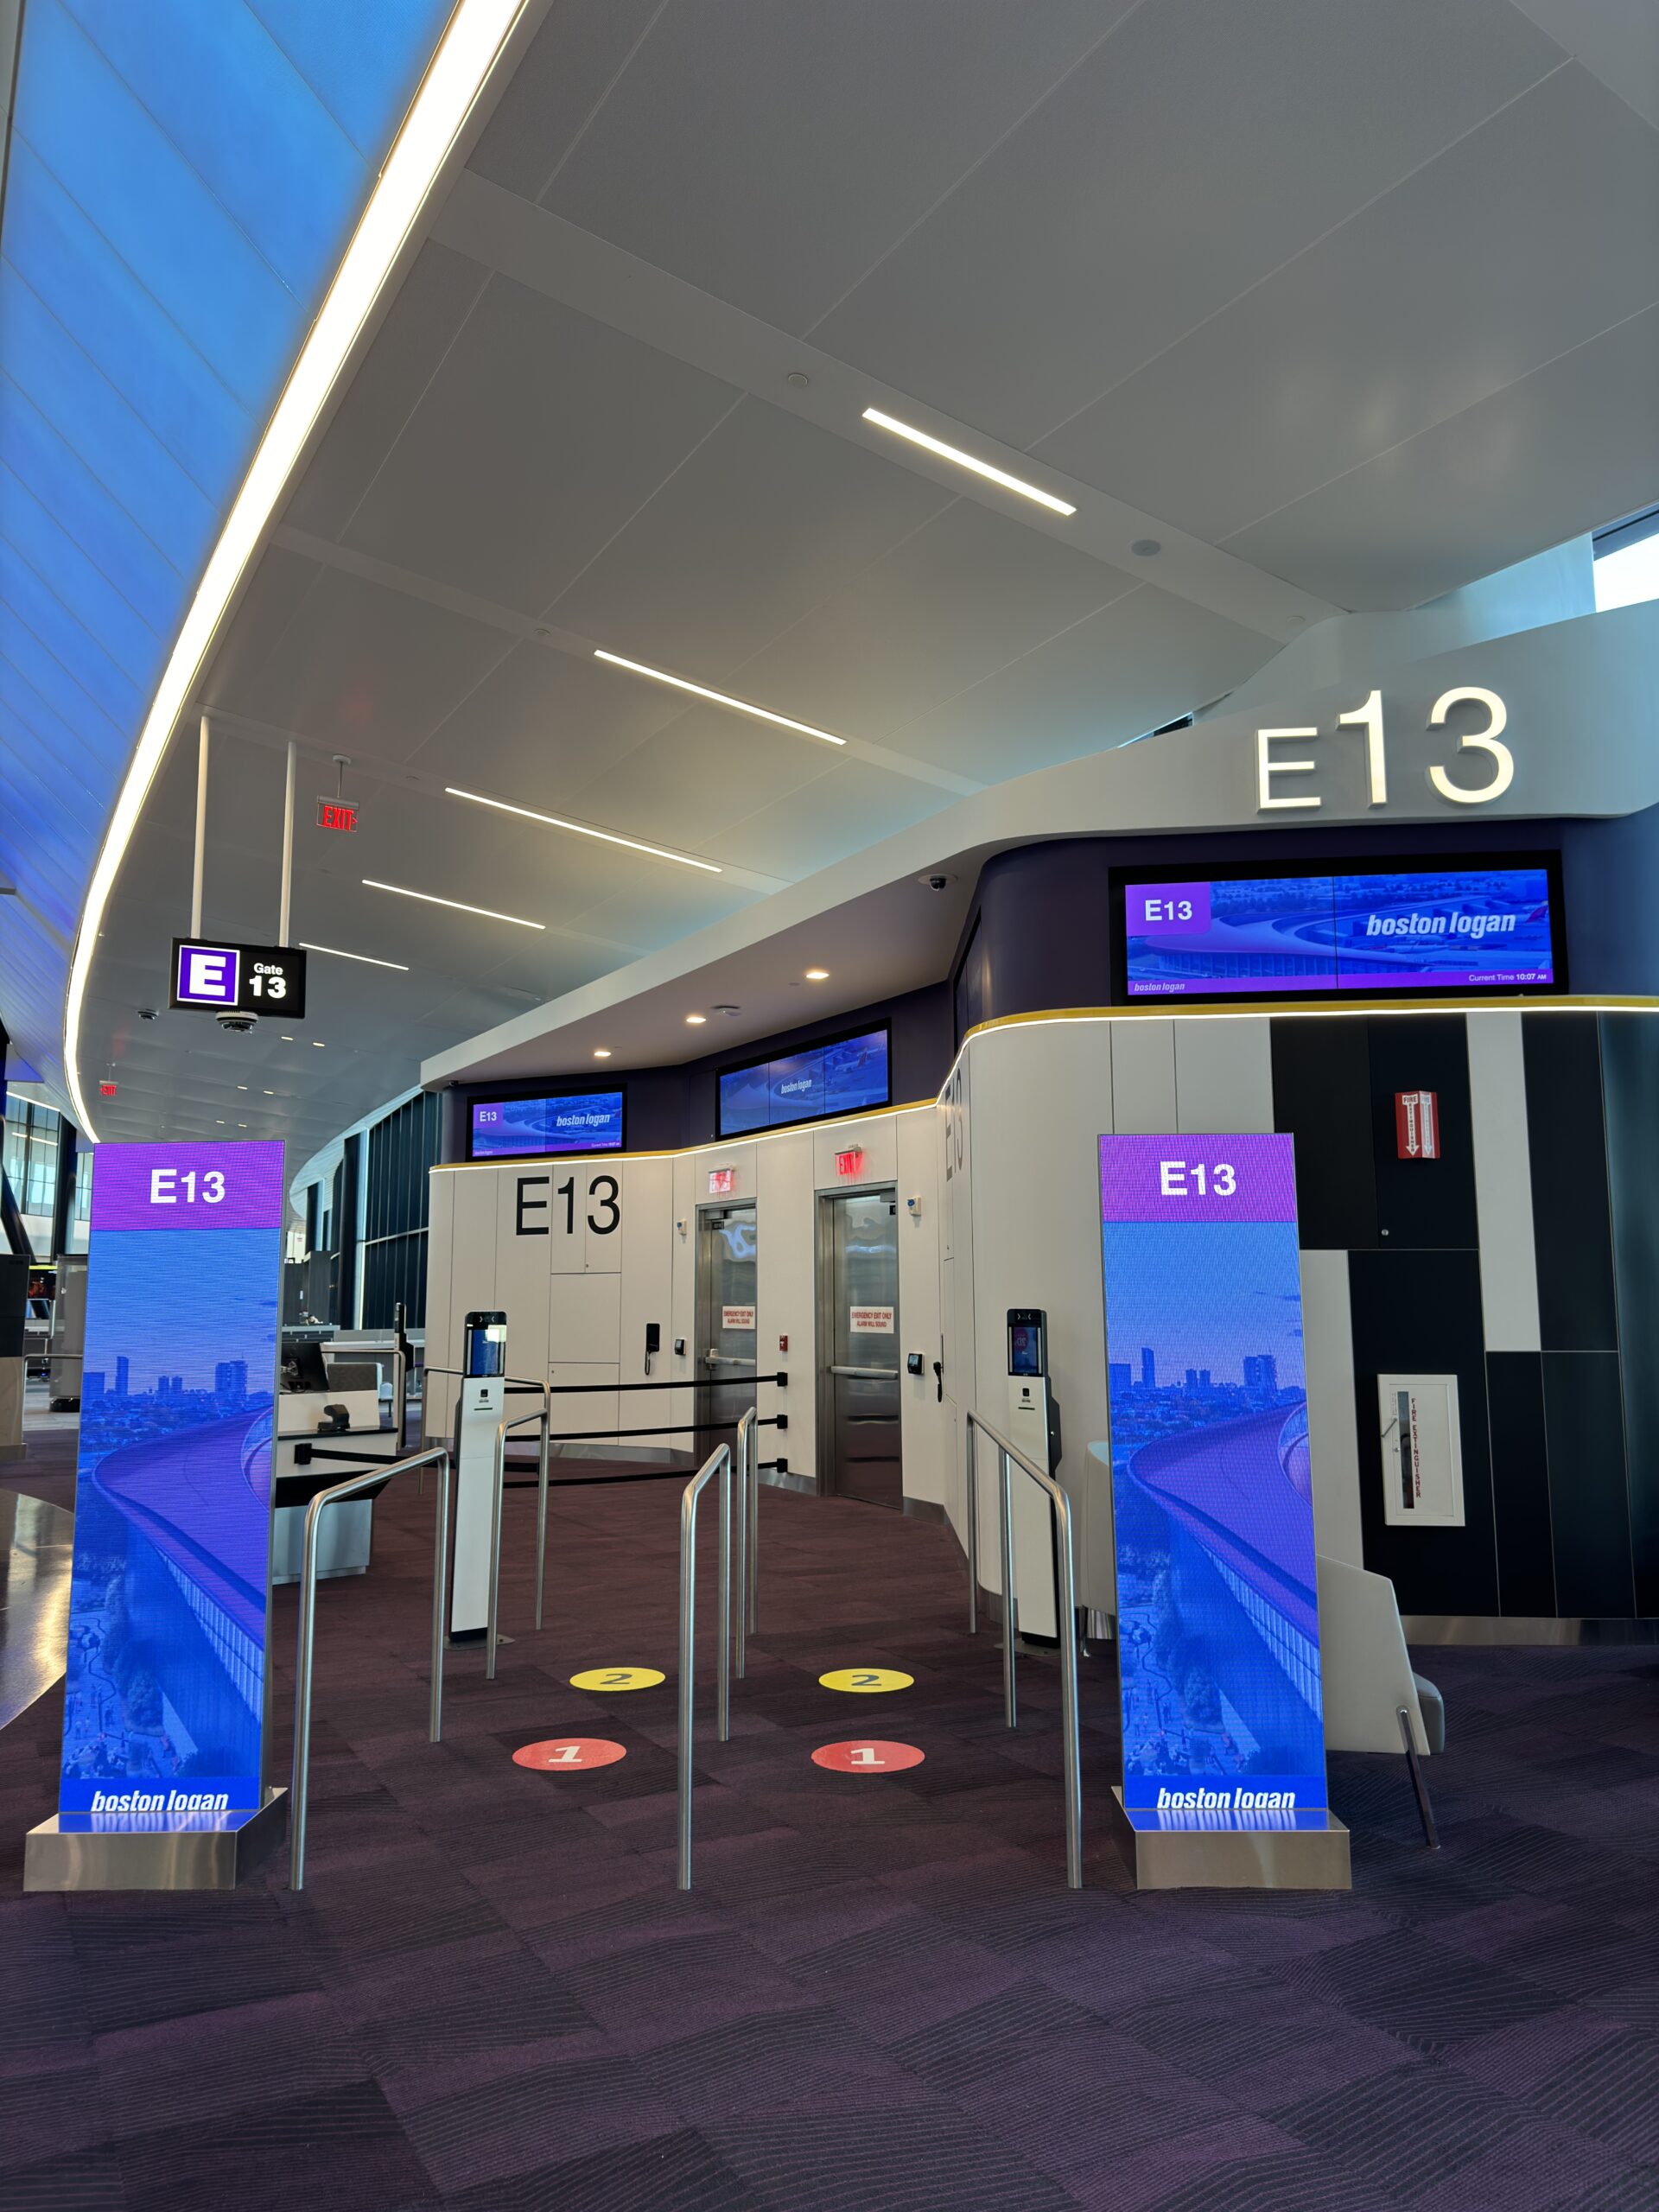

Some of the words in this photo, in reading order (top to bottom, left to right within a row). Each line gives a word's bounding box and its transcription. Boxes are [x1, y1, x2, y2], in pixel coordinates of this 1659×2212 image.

[1256, 686, 1515, 811] E13
[323, 805, 353, 830] EXIT
[1145, 899, 1192, 921] E13
[1366, 912, 1446, 936] boston
[1448, 912, 1516, 939] logan
[188, 953, 226, 996] E
[253, 963, 283, 976] Gate
[249, 975, 287, 999] 13
[1134, 983, 1161, 992] boston
[1162, 982, 1185, 993] logan
[781, 1082, 798, 1094] boston
[797, 1080, 812, 1092] logan
[480, 1111, 497, 1122] E13
[556, 1115, 585, 1127] boston
[586, 1114, 610, 1127] logan
[150, 1168, 226, 1204] E13
[1160, 1160, 1236, 1196] E13
[516, 1175, 620, 1236] E13
[1412, 1425, 1421, 1497] EXTINGUISHER
[600, 1673, 632, 1685] 2
[851, 1674, 882, 1686] 2
[548, 1745, 583, 1763] 1
[851, 1748, 885, 1764] 1
[91, 1790, 165, 1812] boston
[166, 1789, 229, 1811] logan
[1157, 1788, 1231, 1808] boston
[1234, 1788, 1295, 1808] logan
